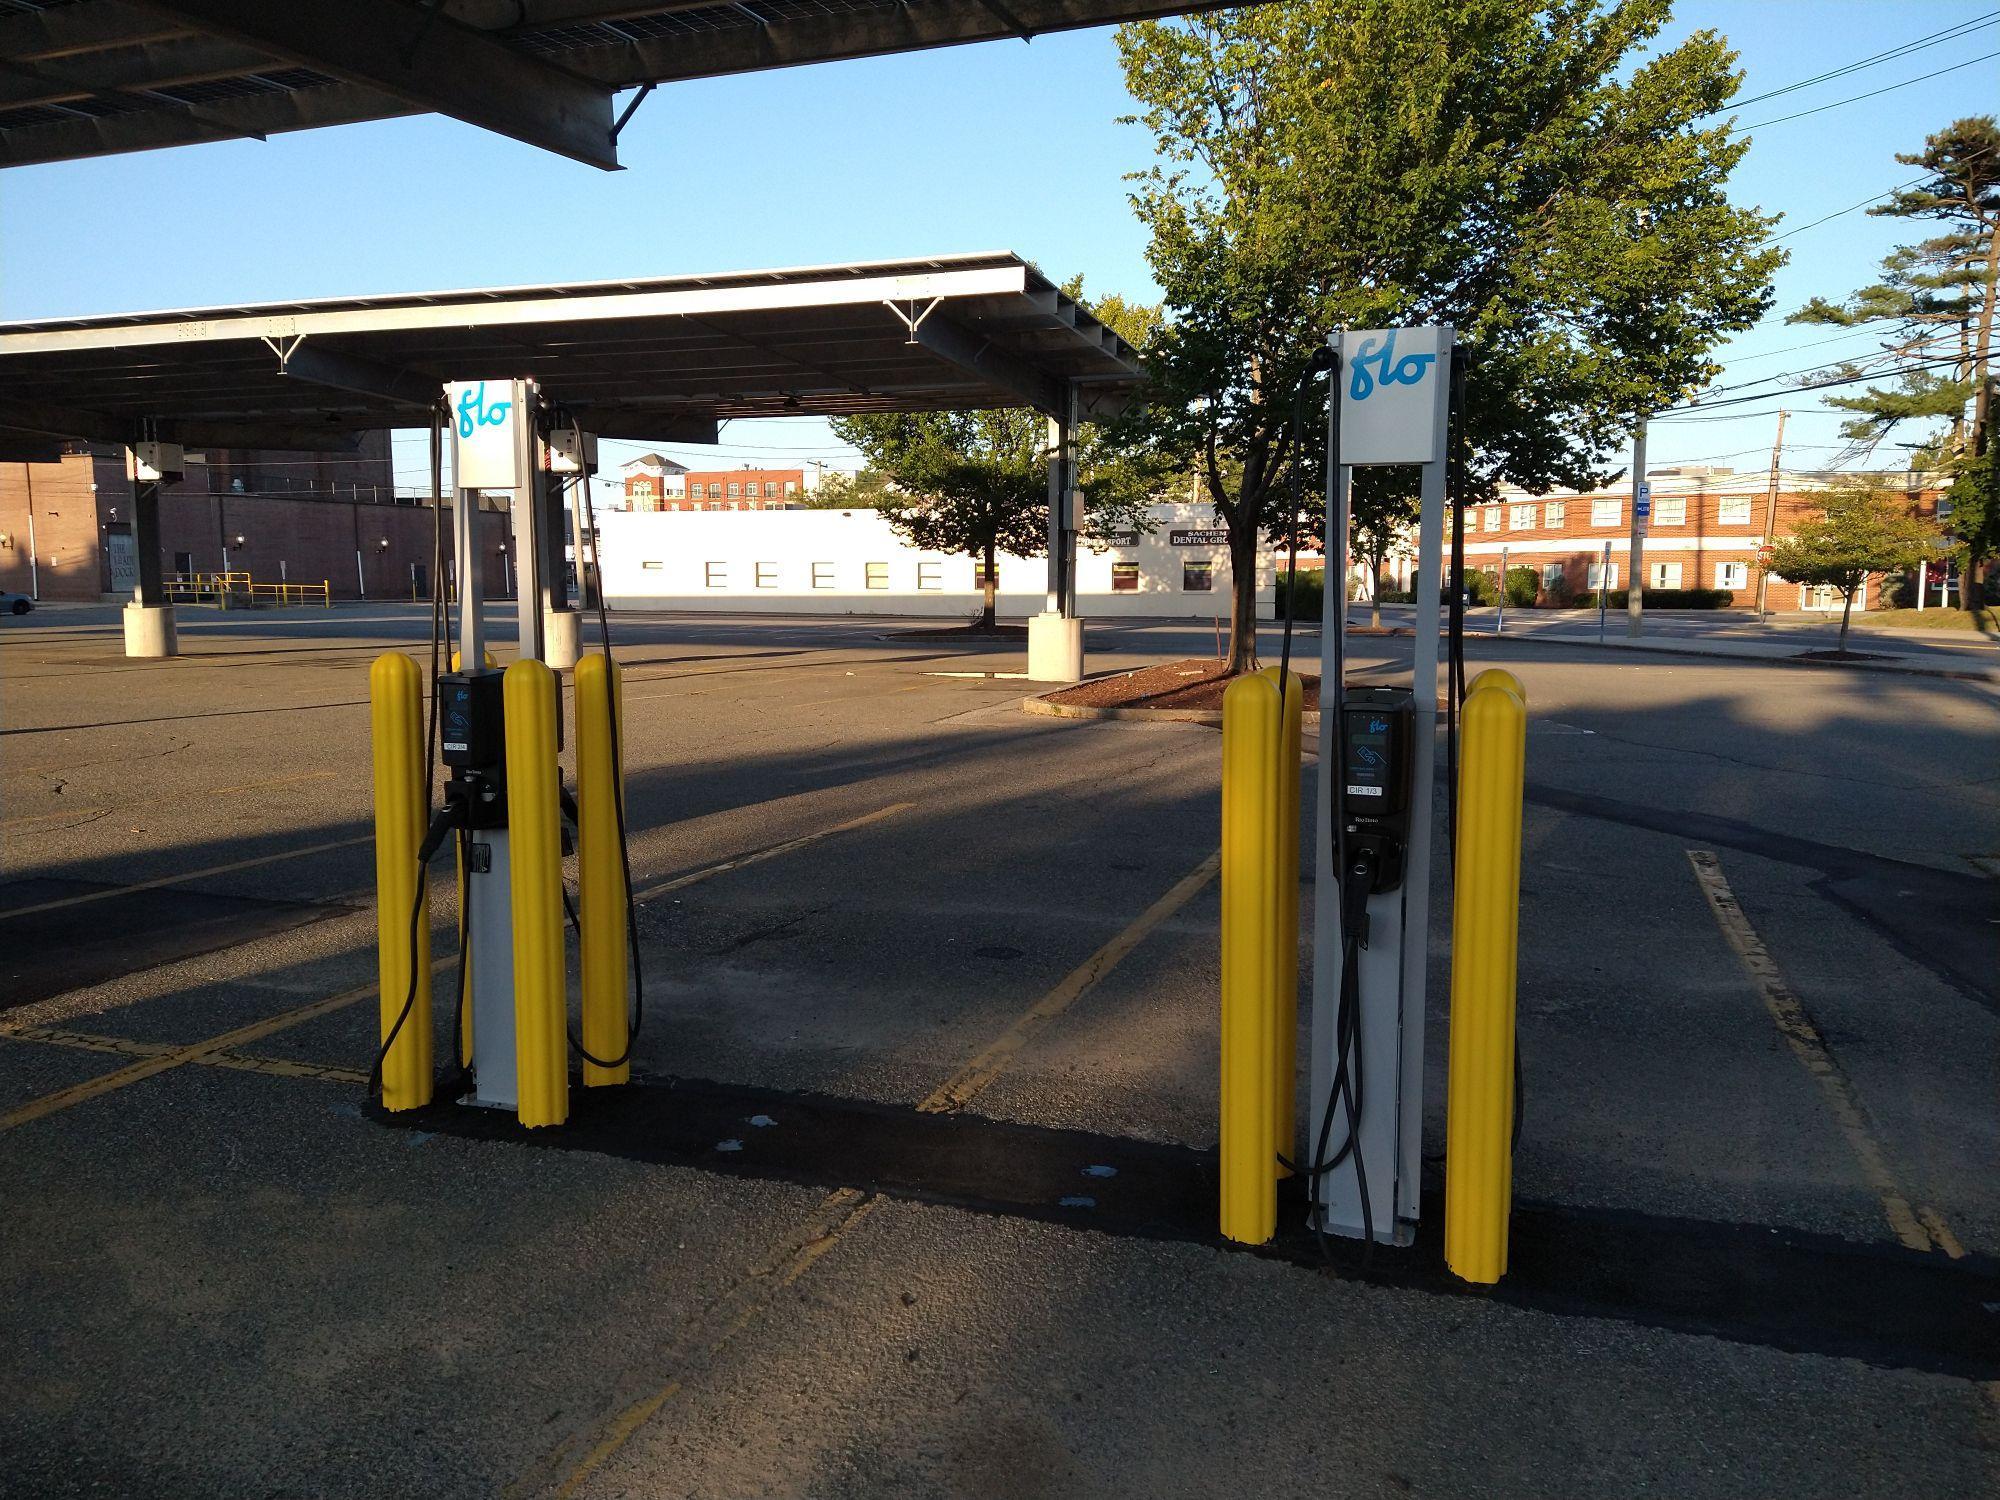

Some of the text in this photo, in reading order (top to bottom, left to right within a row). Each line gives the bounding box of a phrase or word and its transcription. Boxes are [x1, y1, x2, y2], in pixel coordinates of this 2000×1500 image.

[1350, 328, 1436, 401] flo
[457, 382, 511, 438] flo
[1173, 535, 1229, 544] DENTAL GRO
[1369, 720, 1389, 734] flo
[1349, 786, 1378, 795] CIR 1/3
